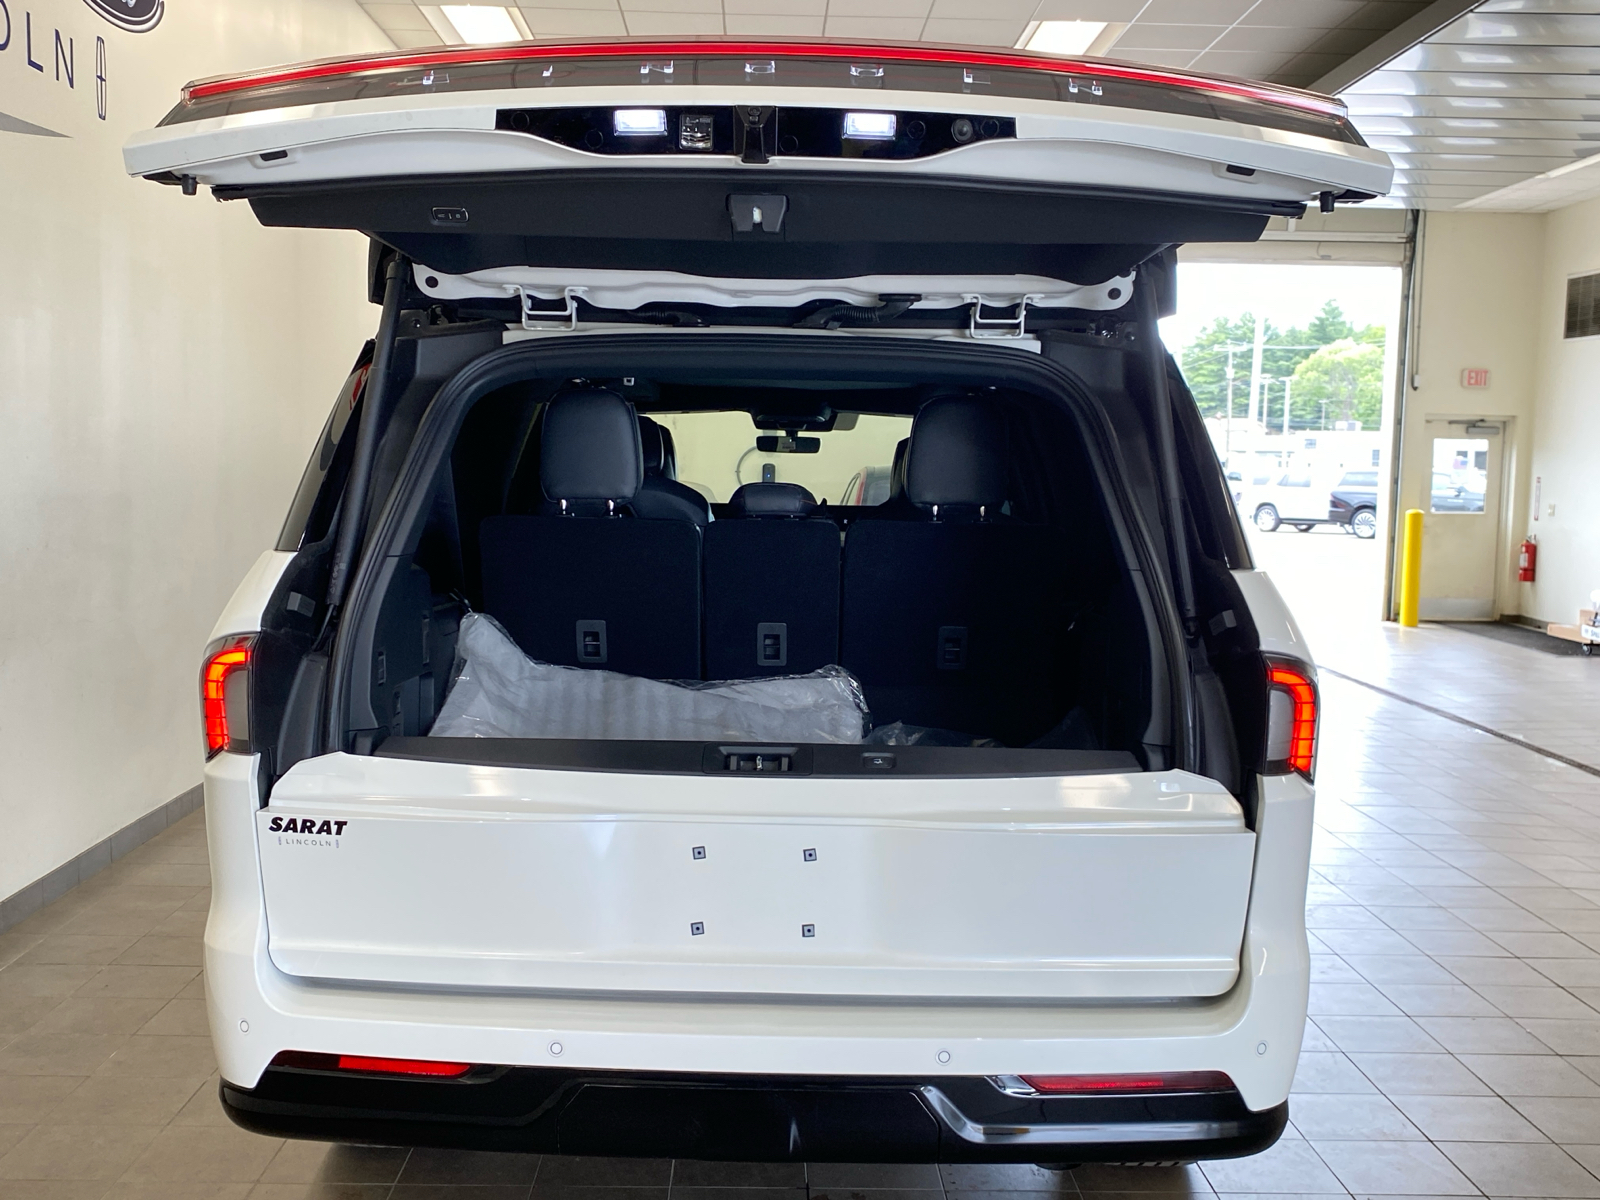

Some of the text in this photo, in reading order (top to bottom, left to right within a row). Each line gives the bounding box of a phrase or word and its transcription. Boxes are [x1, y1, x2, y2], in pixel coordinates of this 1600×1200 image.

[1467, 370, 1488, 386] EXIT
[269, 816, 348, 836] SARAT
[285, 838, 332, 847] LINCOLN
